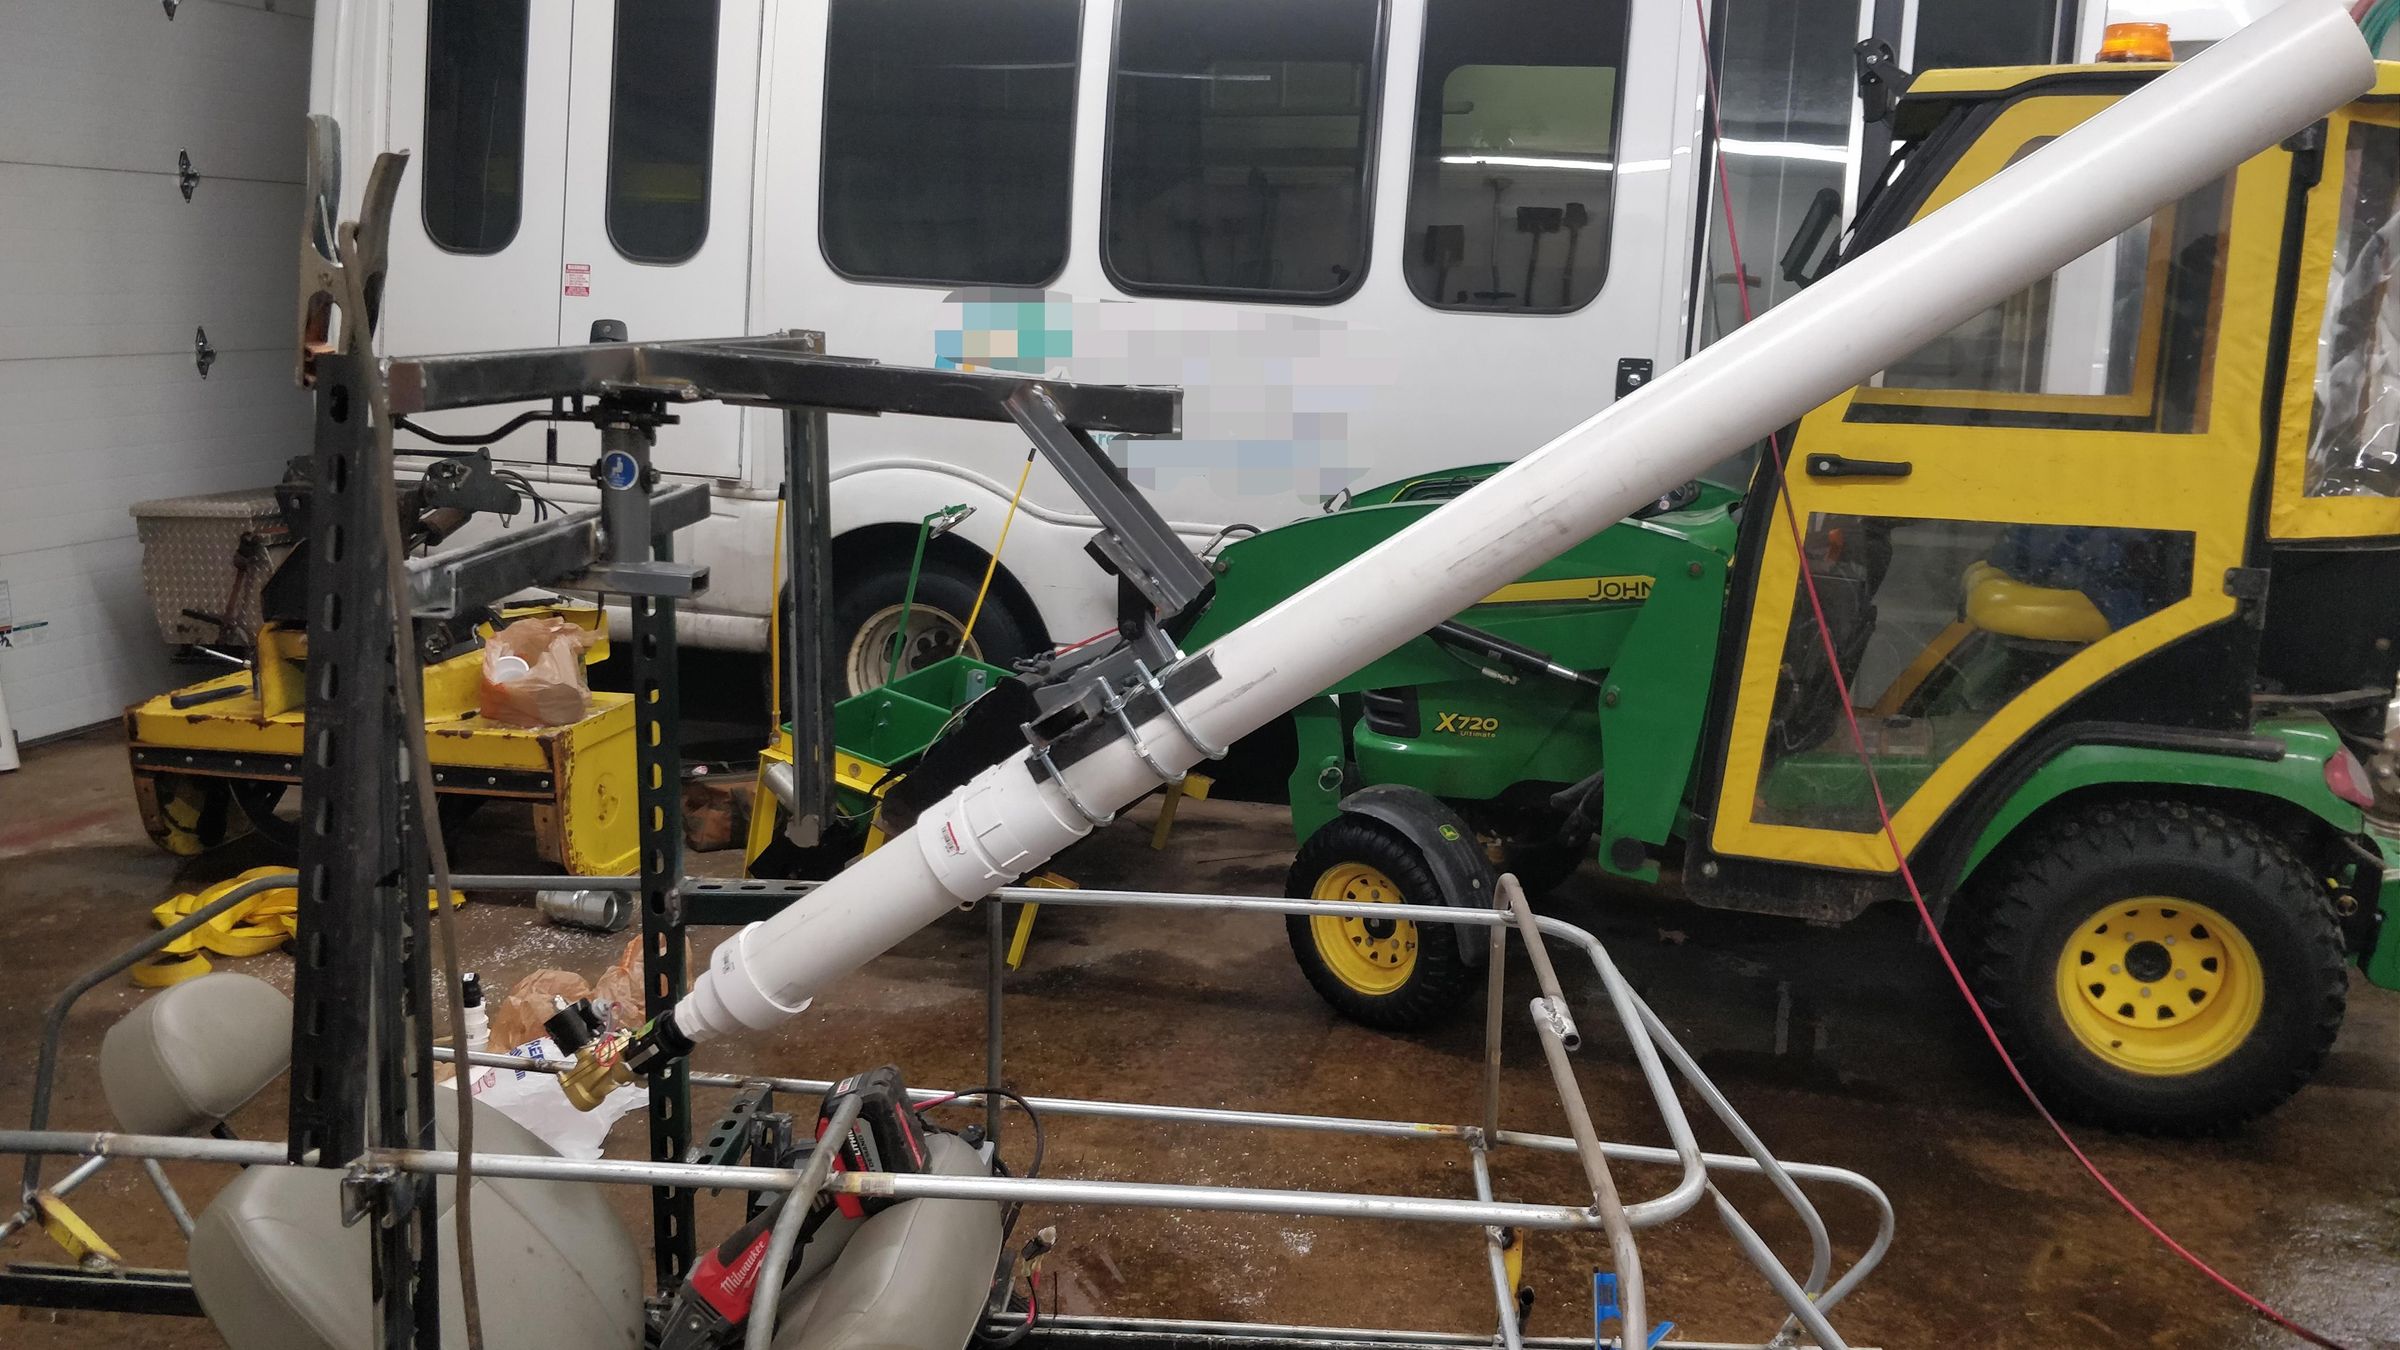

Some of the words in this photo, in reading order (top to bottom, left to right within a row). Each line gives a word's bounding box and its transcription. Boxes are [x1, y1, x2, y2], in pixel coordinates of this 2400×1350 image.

[1588, 579, 1652, 598] JOHN
[1434, 711, 1499, 732] X720
[720, 1240, 765, 1297] Milwaukee
